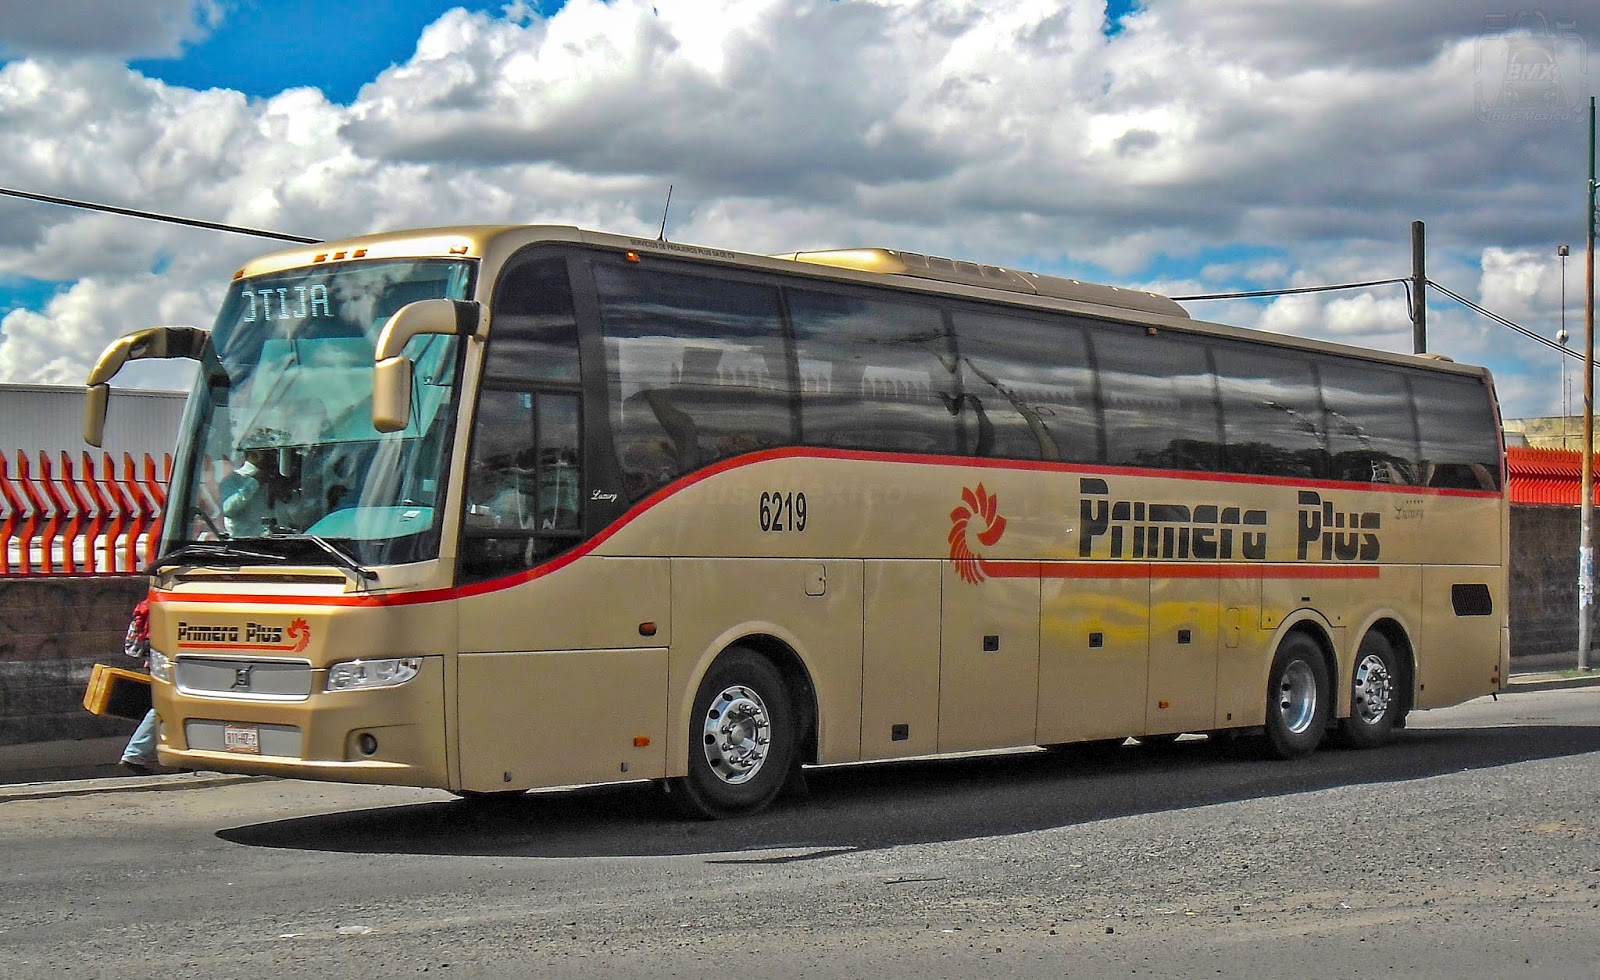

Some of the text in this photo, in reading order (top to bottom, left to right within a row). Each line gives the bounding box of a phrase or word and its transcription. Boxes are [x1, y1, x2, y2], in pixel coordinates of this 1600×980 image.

[590, 489, 618, 503] Luxury
[759, 491, 807, 532] 6219
[1079, 477, 1381, 561] Primera Plus
[178, 621, 283, 643] Primera Plus
